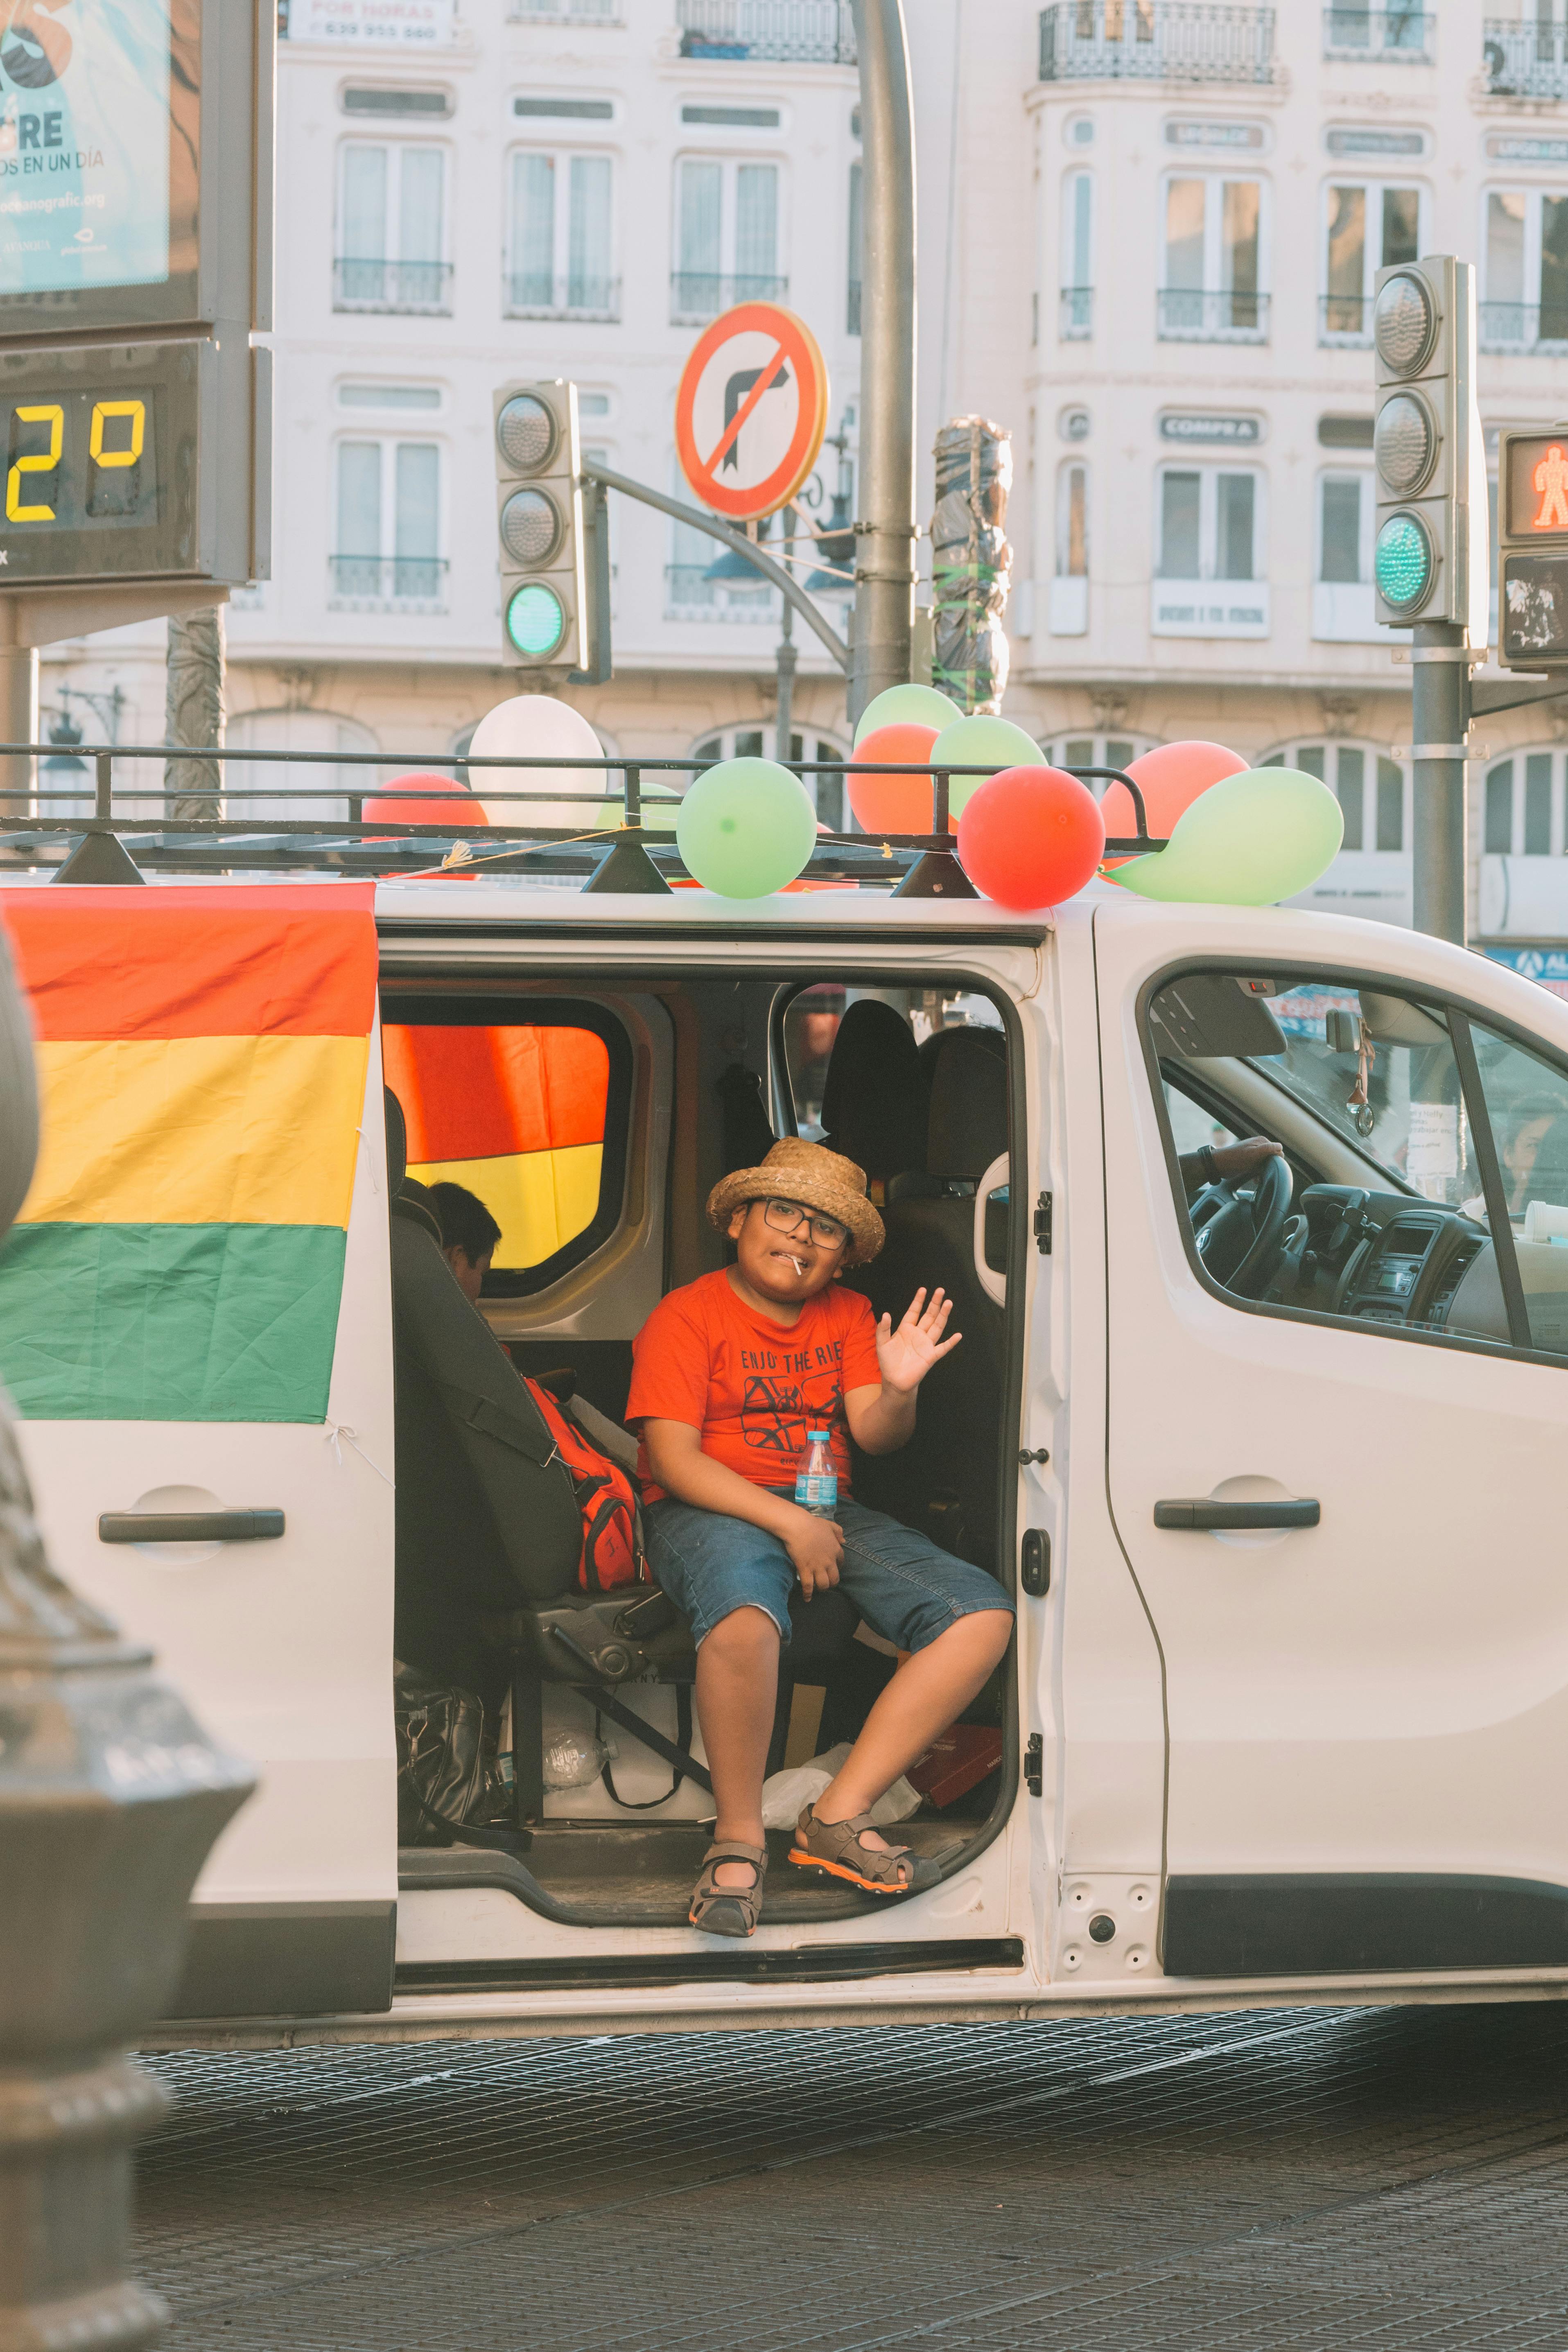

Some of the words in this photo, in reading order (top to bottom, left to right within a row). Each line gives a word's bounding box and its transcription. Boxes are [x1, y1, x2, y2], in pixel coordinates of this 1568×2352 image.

[361, 3, 434, 19] HORAS
[0, 111, 63, 150] RE
[23, 155, 43, 174] EN
[49, 152, 70, 171] UN
[76, 145, 104, 169] DÍA
[1165, 420, 1252, 435] COMPRA
[741, 1350, 777, 1370] ENJO
[783, 1351, 813, 1374] THE
